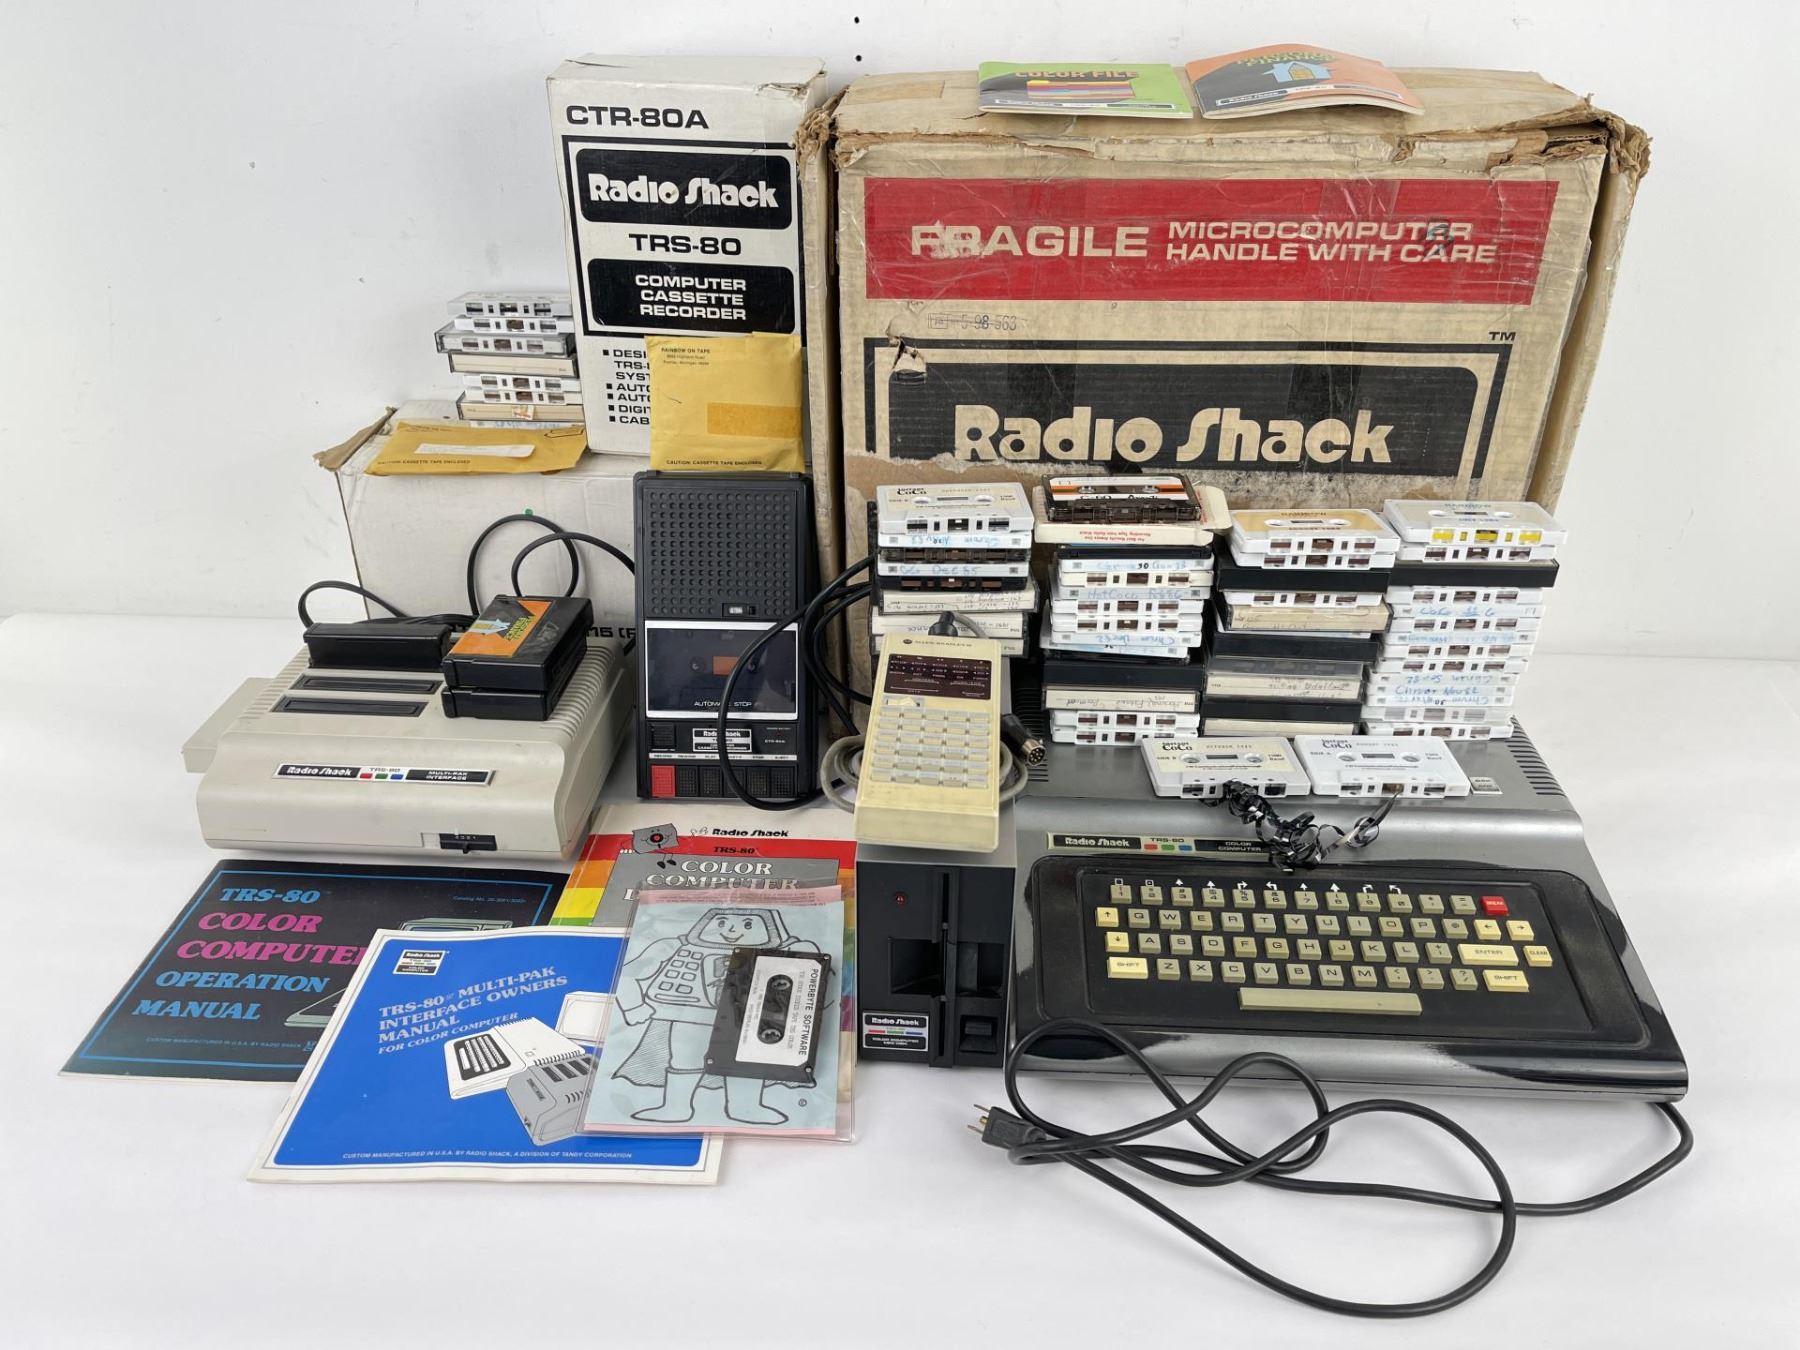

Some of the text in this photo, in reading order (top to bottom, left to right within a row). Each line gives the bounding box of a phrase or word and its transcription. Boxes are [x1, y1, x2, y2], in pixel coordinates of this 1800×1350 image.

[566, 105, 709, 129] CTR-80A
[588, 173, 779, 208] Radio Shack
[911, 224, 1149, 258] FRAGILE
[1168, 221, 1473, 241] MICROCOMPUTER
[628, 233, 742, 255] TRS-80
[1166, 244, 1498, 264] HANDLE WITH CARE
[635, 274, 747, 291] COMPUTER
[640, 290, 744, 306] CASSETTE
[639, 304, 747, 320] RECORDER
[1488, 331, 1516, 341] TM
[954, 404, 1394, 464] Radio Shack
[286, 766, 352, 776] Radio Shack
[712, 828, 789, 838] Radio Shack
[1065, 836, 1130, 847] Radio Shack
[713, 846, 755, 855] TRS-80
[681, 860, 773, 875] COLOR
[646, 874, 800, 890] COMPUTER
[219, 887, 321, 904] TRS-80
[198, 912, 323, 933] COLOR
[1144, 936, 1155, 944] A
[1208, 939, 1219, 947] D
[1368, 944, 1379, 952] K
[1196, 963, 1207, 971] X
[1261, 966, 1271, 974] V
[156, 970, 330, 993] OPERATION
[379, 966, 557, 1018] TRS-80 MULTI-PAK
[131, 1000, 261, 1020] MANUAL
[378, 975, 569, 1031] INTERFACE OWNERS
[799, 968, 819, 1056] POWERBYTE SOFTWARE
[378, 1015, 460, 1044] MANUAL
[871, 1017, 896, 1025] Radio
[378, 1011, 519, 1055] FOR COLOR COMPUTER
